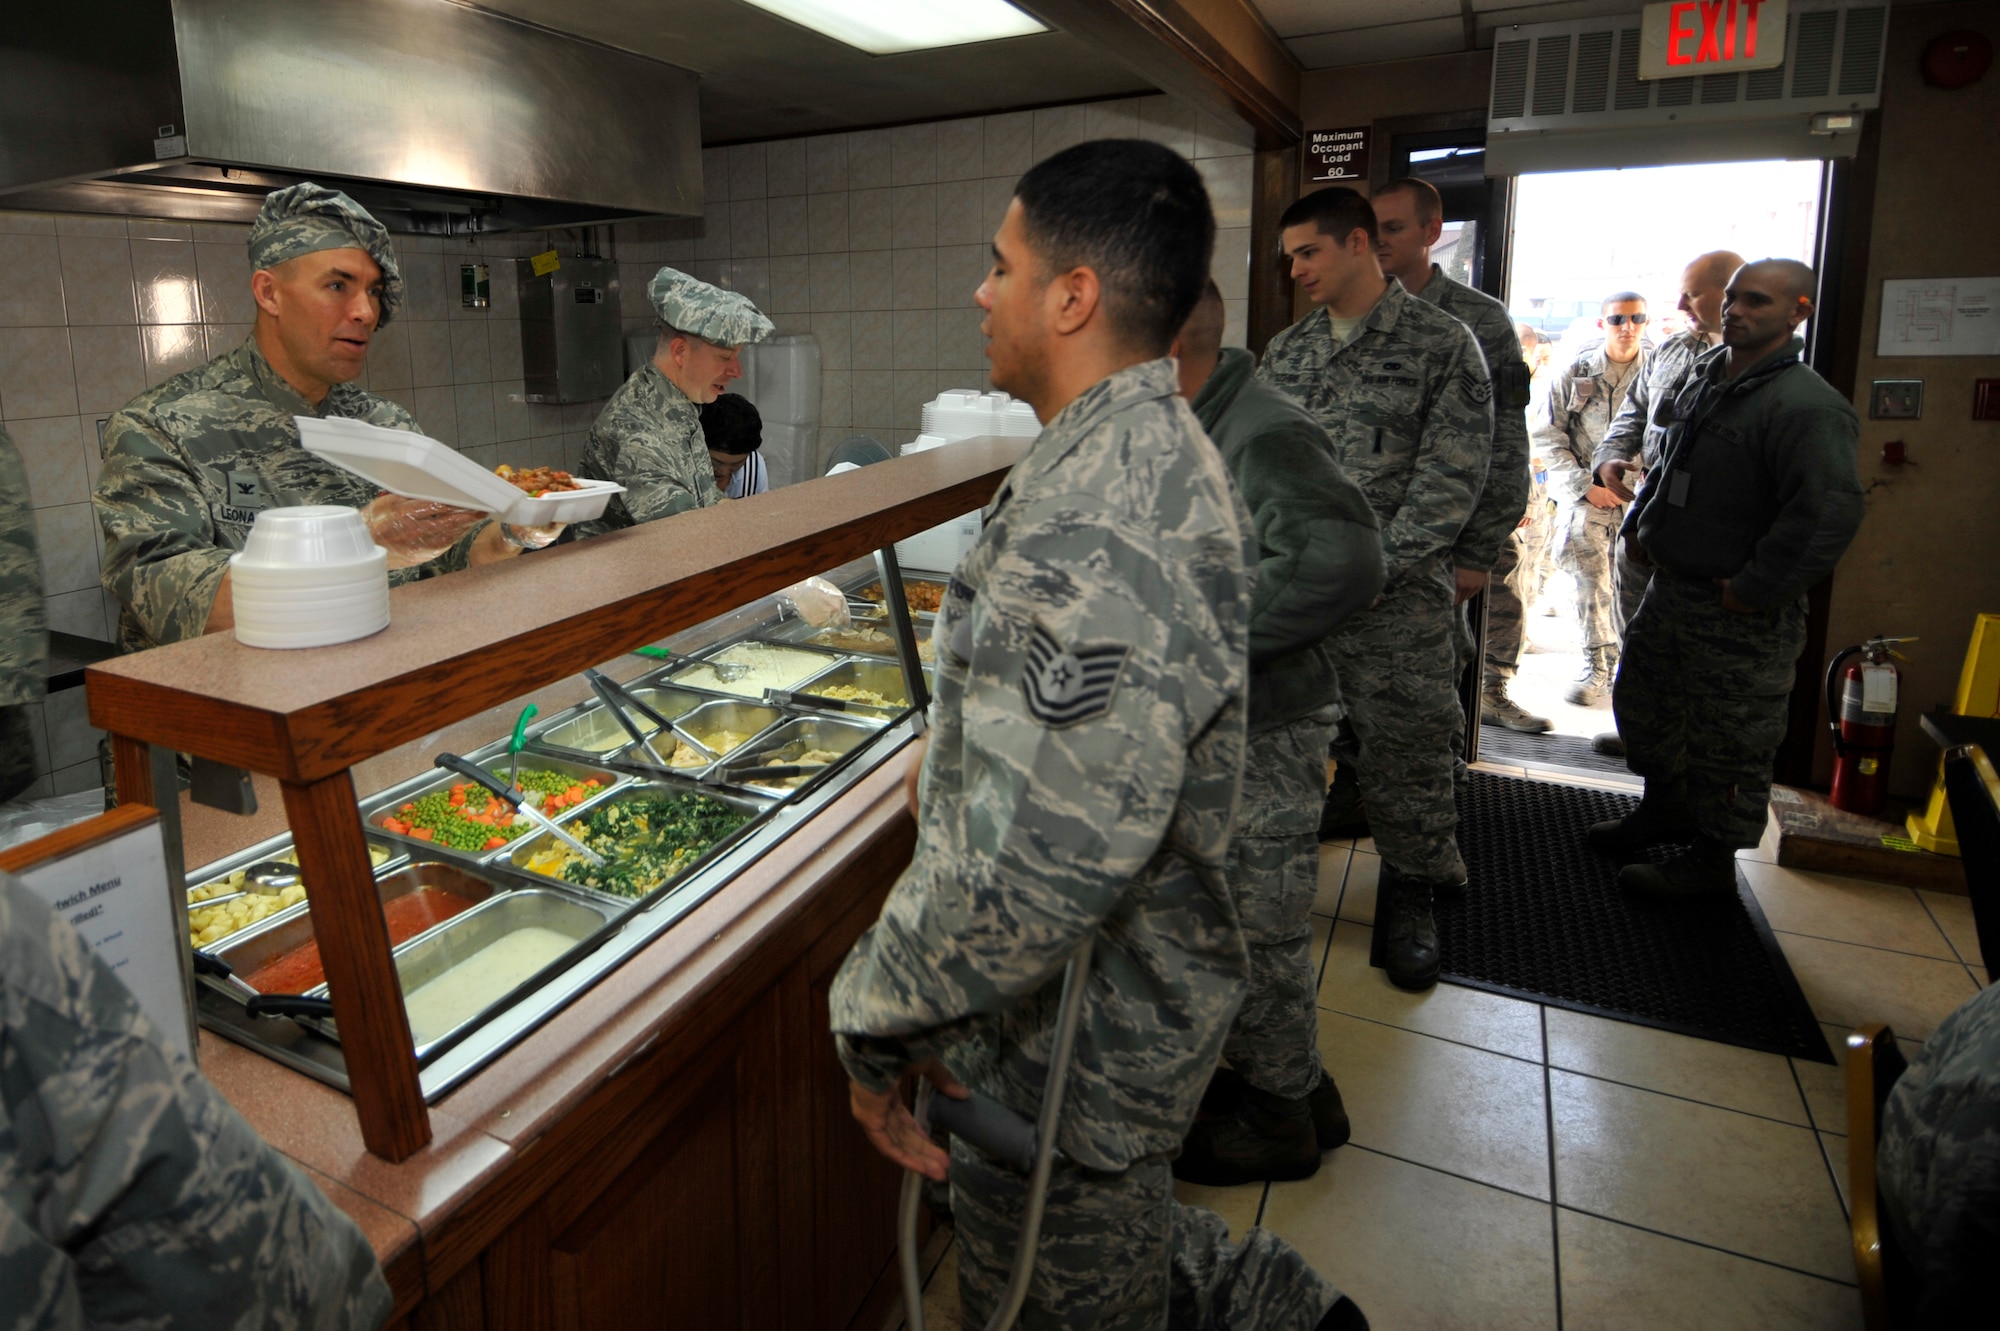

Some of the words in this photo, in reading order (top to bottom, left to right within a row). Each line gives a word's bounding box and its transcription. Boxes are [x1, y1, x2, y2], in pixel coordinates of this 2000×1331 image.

[1667, 0, 1767, 66] EXIT
[1312, 131, 1364, 143] Maximum
[1311, 142, 1364, 154] Occupant
[1322, 152, 1351, 164] Load
[1327, 166, 1345, 177] 60
[1391, 376, 1420, 388] FORCE
[221, 505, 255, 524] LEONA
[88, 876, 122, 897] Menu
